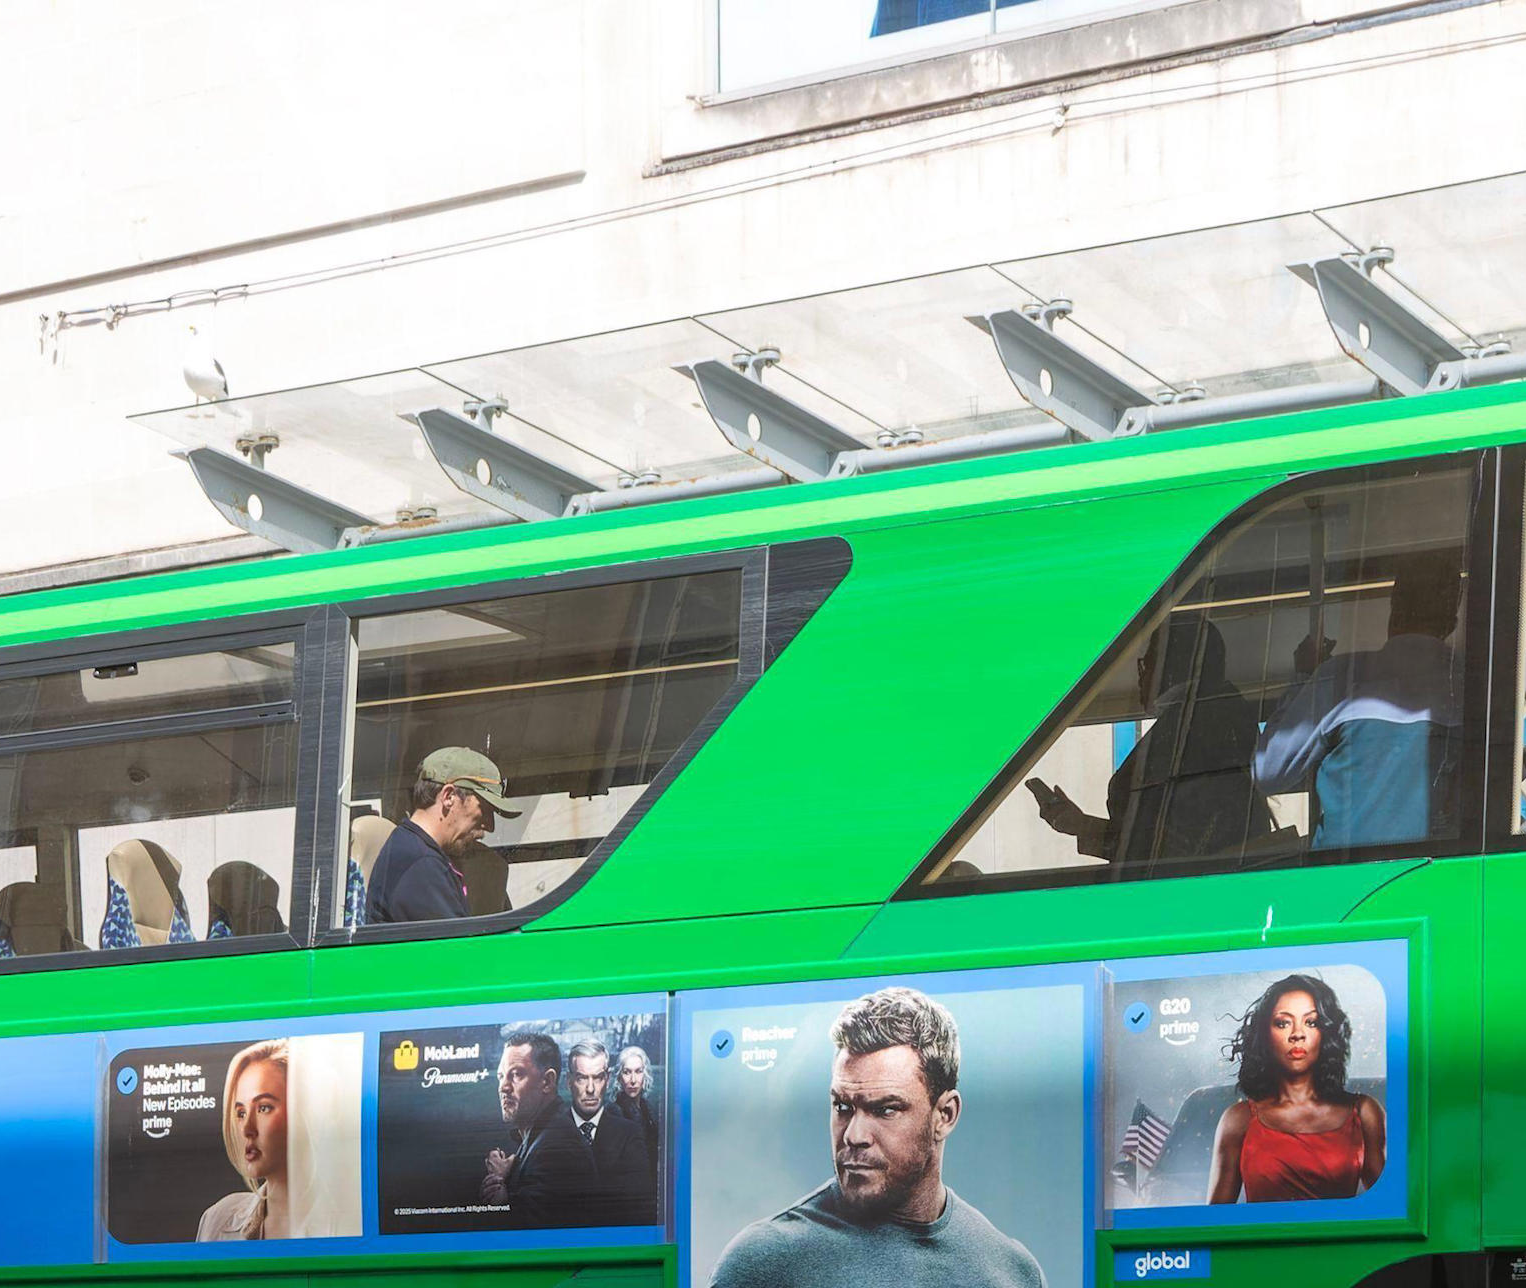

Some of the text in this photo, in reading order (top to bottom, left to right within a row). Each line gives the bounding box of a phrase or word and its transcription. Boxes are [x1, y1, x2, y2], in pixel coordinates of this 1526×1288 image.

[1160, 998, 1191, 1015] G20
[742, 1026, 798, 1042] Reacher
[1160, 1020, 1199, 1039] prime
[424, 1043, 480, 1061] MobLand
[741, 1047, 777, 1064] prime
[143, 1063, 202, 1080] Molly-Mae:
[143, 1080, 181, 1096] Behind
[191, 1078, 206, 1092] all
[143, 1095, 216, 1113] New Episodes
[142, 1115, 173, 1132] prime
[1135, 1250, 1190, 1278] global
